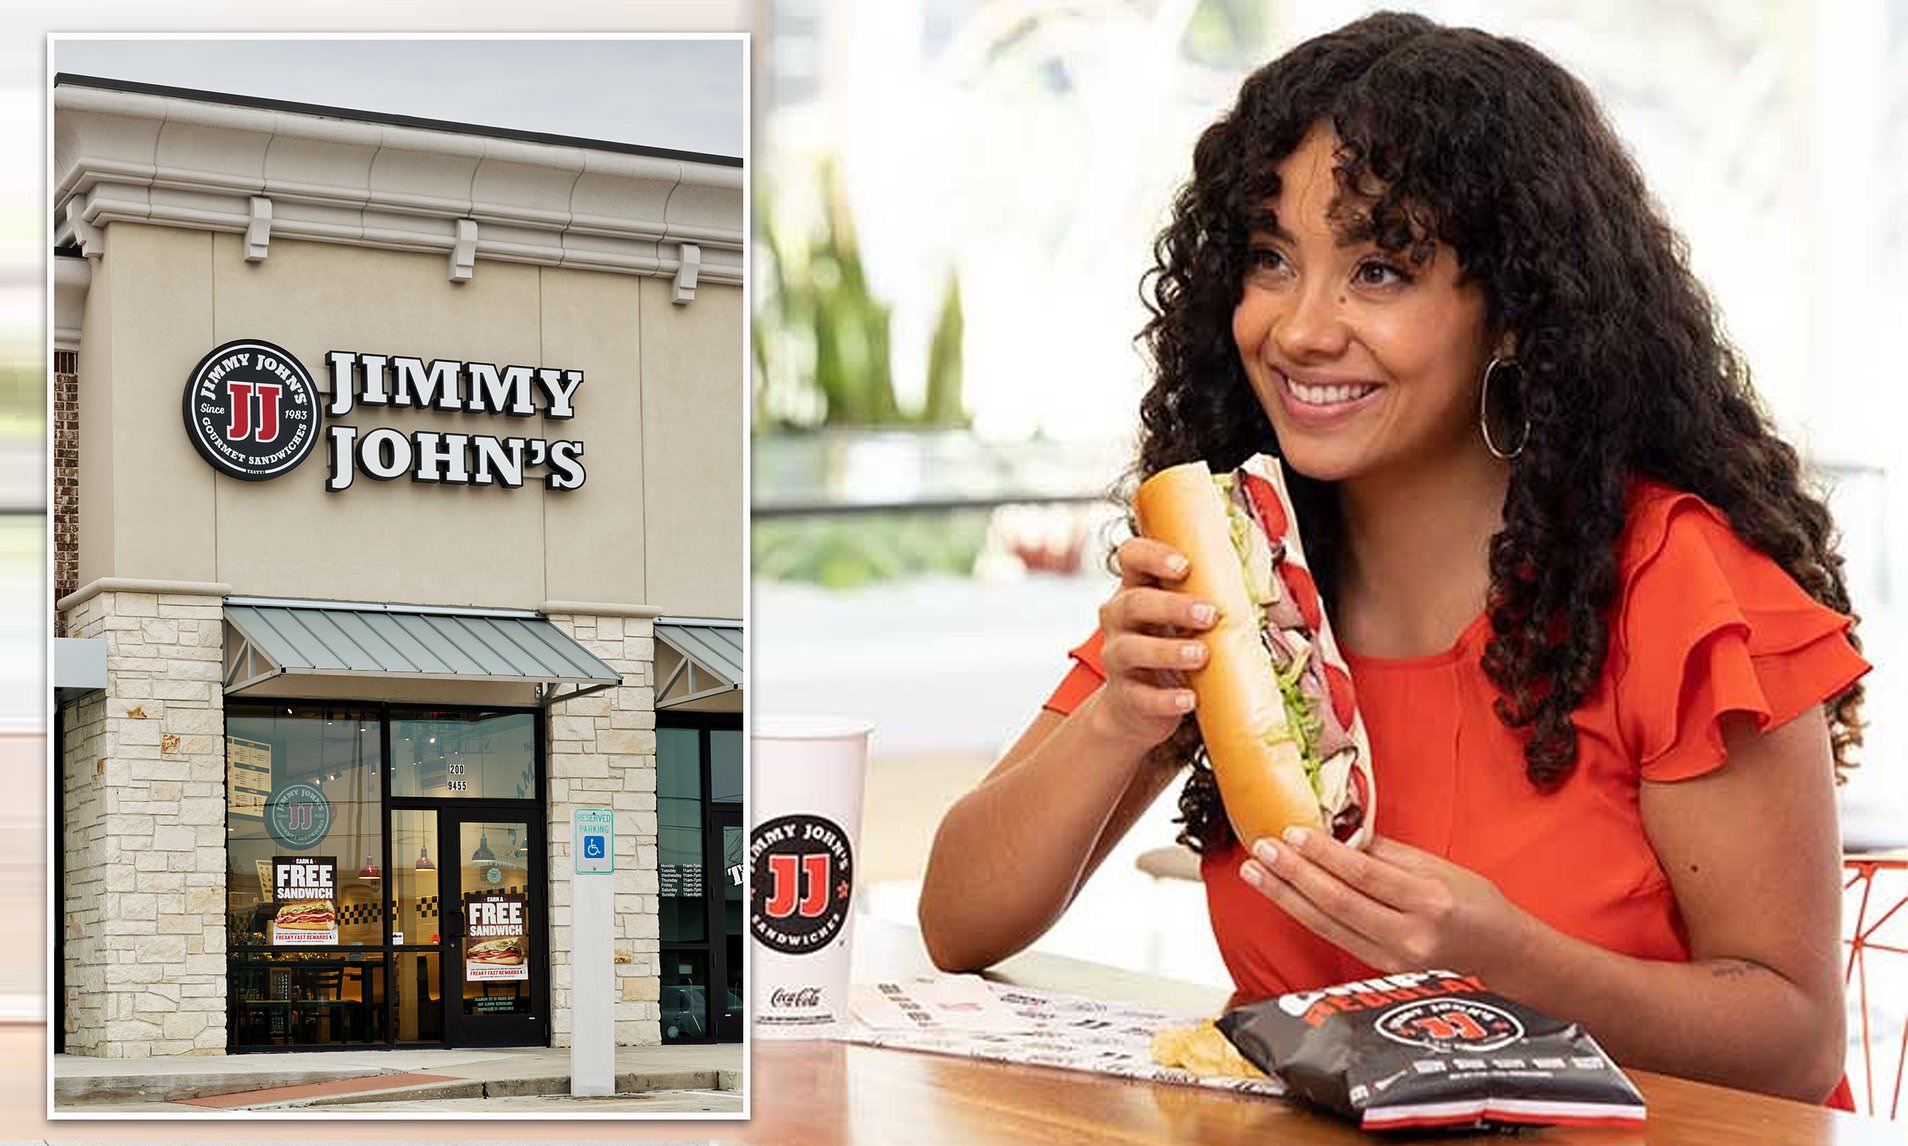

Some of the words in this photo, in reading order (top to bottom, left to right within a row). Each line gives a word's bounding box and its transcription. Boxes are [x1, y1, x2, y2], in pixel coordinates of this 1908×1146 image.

[200, 353, 250, 400] JIMMY
[256, 354, 307, 404] JOHN'S
[326, 351, 583, 419] JIMMY
[200, 403, 225, 414] Since
[227, 380, 282, 443] JJ
[285, 410, 307, 420] 1983
[202, 417, 245, 462] GOURMET
[248, 423, 307, 465] SANDWICHES
[325, 426, 586, 492] JOHN'S
[450, 764, 464, 774] 200
[447, 781, 467, 791] 9455
[289, 803, 313, 831] JJ
[277, 865, 333, 887] FREE
[765, 853, 831, 918] JJ
[277, 888, 333, 899] SANDWICH
[469, 903, 522, 925] FREE
[470, 925, 523, 936] SANDWICH
